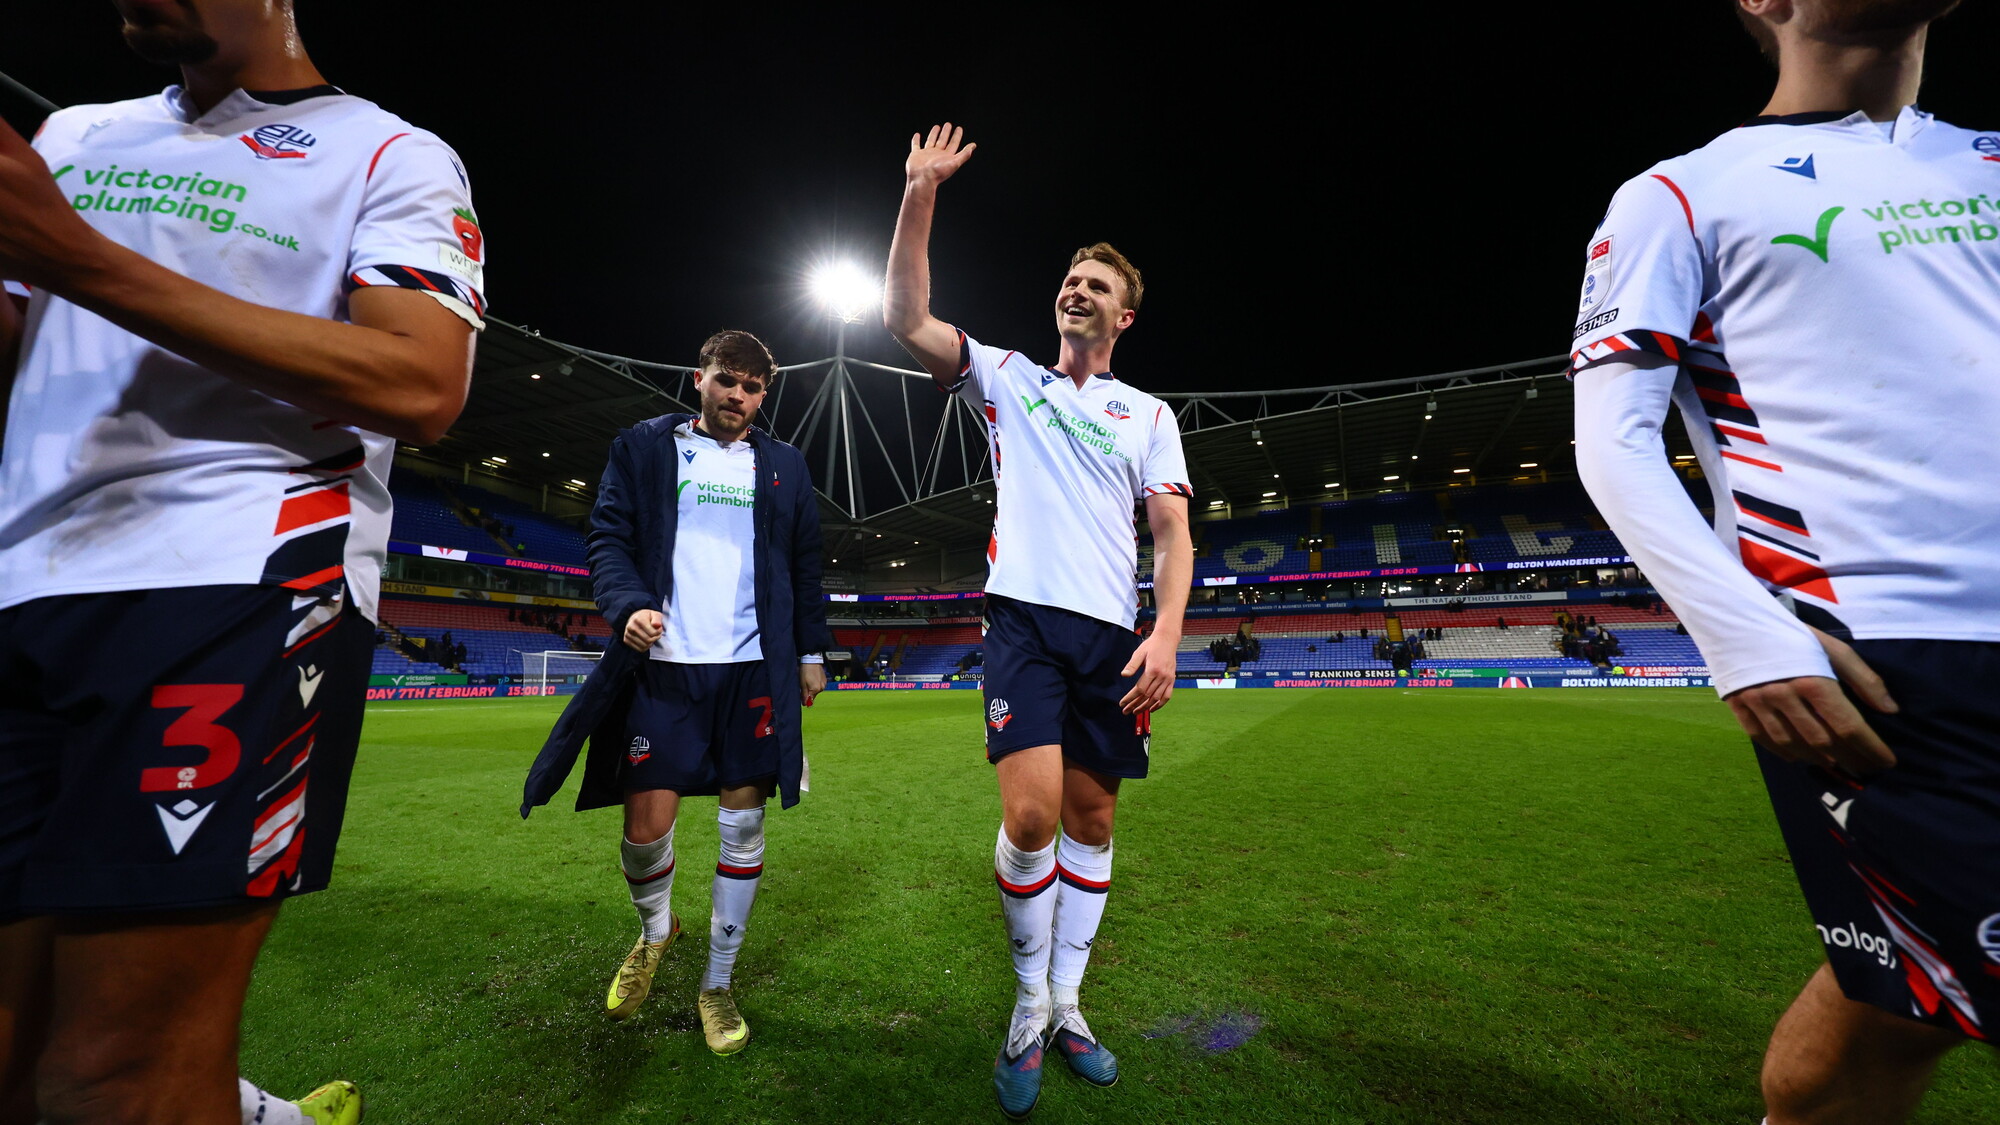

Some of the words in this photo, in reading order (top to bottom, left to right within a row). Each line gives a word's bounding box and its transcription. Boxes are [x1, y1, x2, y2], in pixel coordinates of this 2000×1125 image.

[84, 165, 247, 204] victorian
[1862, 194, 2000, 222] victori
[72, 189, 300, 252] plumbing.co.uk
[1050, 404, 1117, 440] victorian
[505, 558, 549, 571] SATURDAY
[550, 564, 565, 573] 7TH
[1507, 561, 1537, 569] BOLTON
[1539, 557, 1608, 567] WANDERERS
[1268, 574, 1310, 582] SATURDAY
[1328, 570, 1372, 579] FEBRUARY
[1380, 568, 1404, 576] 15:00
[1405, 567, 1418, 575] KO
[1414, 597, 1431, 605] THE
[1431, 596, 1449, 604] NAT
[1503, 593, 1532, 601] STAND
[1309, 671, 1361, 679] FRANKING
[1365, 670, 1395, 678] SENSE
[1561, 678, 1607, 687] BOLTON
[1609, 677, 1688, 687] WANDERERS
[1273, 680, 1323, 688] SATURDAY
[1344, 679, 1396, 687] FEBRUARY
[1407, 679, 1436, 687] 15:00
[1438, 679, 1453, 687] KO
[398, 687, 425, 699] 7TH
[427, 686, 496, 699] FEBRUARY
[507, 686, 539, 697] 15:00
[139, 683, 245, 793] 3
